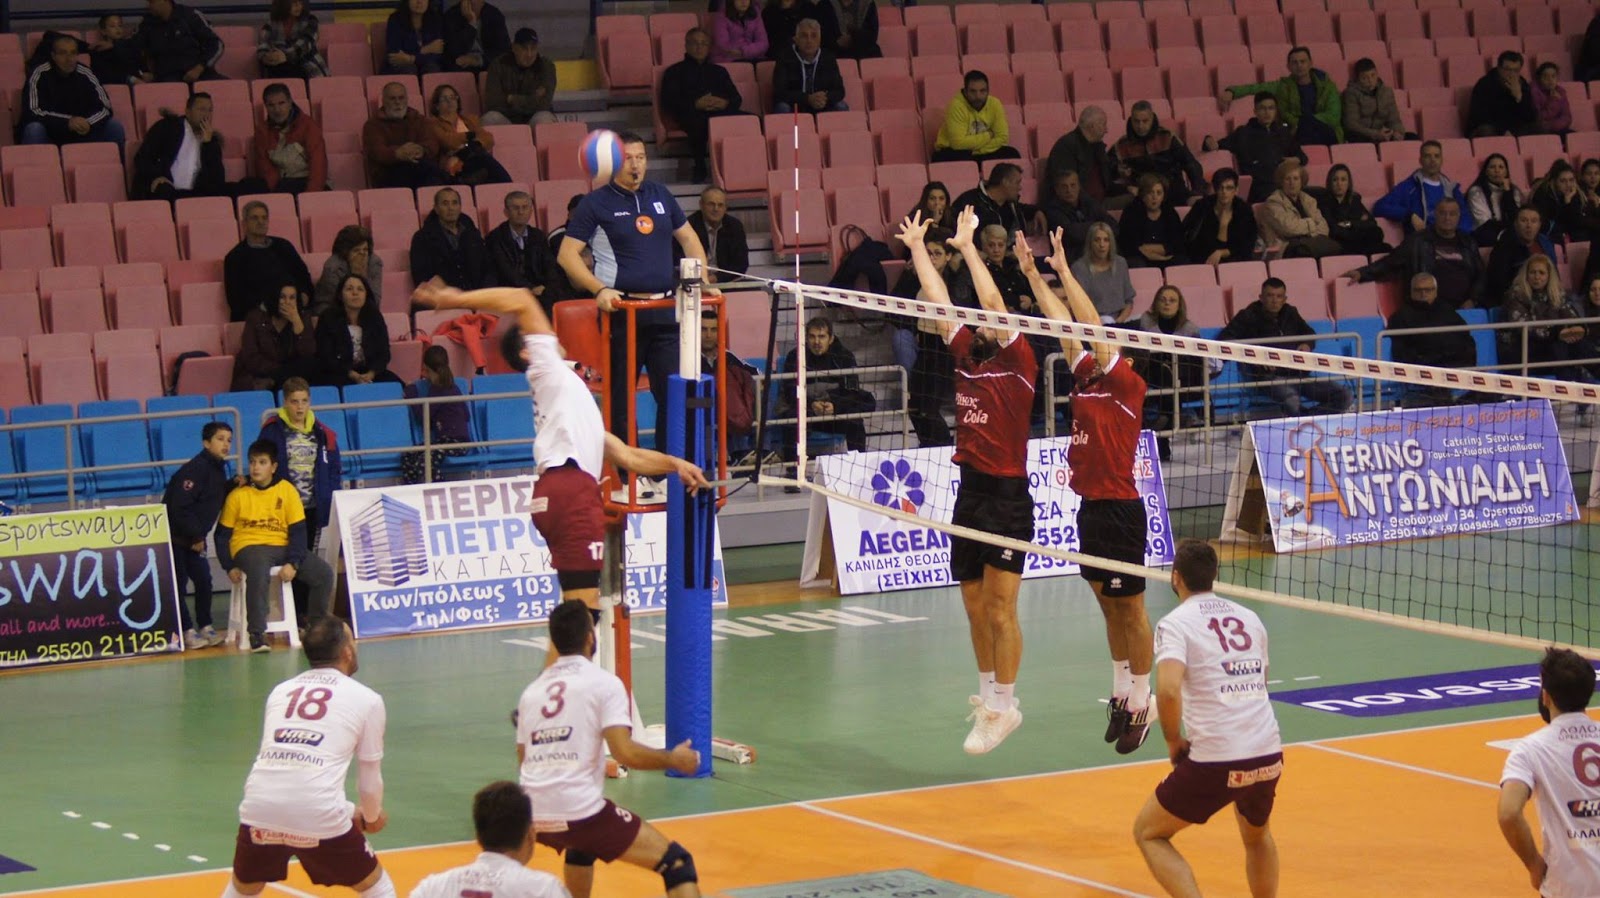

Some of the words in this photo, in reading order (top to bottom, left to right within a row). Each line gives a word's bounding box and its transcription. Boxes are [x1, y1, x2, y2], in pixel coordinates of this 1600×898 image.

[963, 409, 989, 424] Cola
[1443, 436, 1482, 448] Catering
[1485, 432, 1526, 444] Services
[1345, 530, 1379, 544] 25520
[845, 556, 901, 574] ΚΑΝΙΔΗΣ
[877, 567, 950, 593] (ΣΕΪΧΗΣ)
[363, 584, 506, 612] Κων/πόλεως
[511, 576, 554, 597] 103
[27, 615, 61, 633] and
[1207, 616, 1252, 653] 13
[37, 640, 94, 662] 25520
[100, 630, 167, 656] 21125
[284, 686, 334, 721] 18
[541, 681, 567, 719] 3
